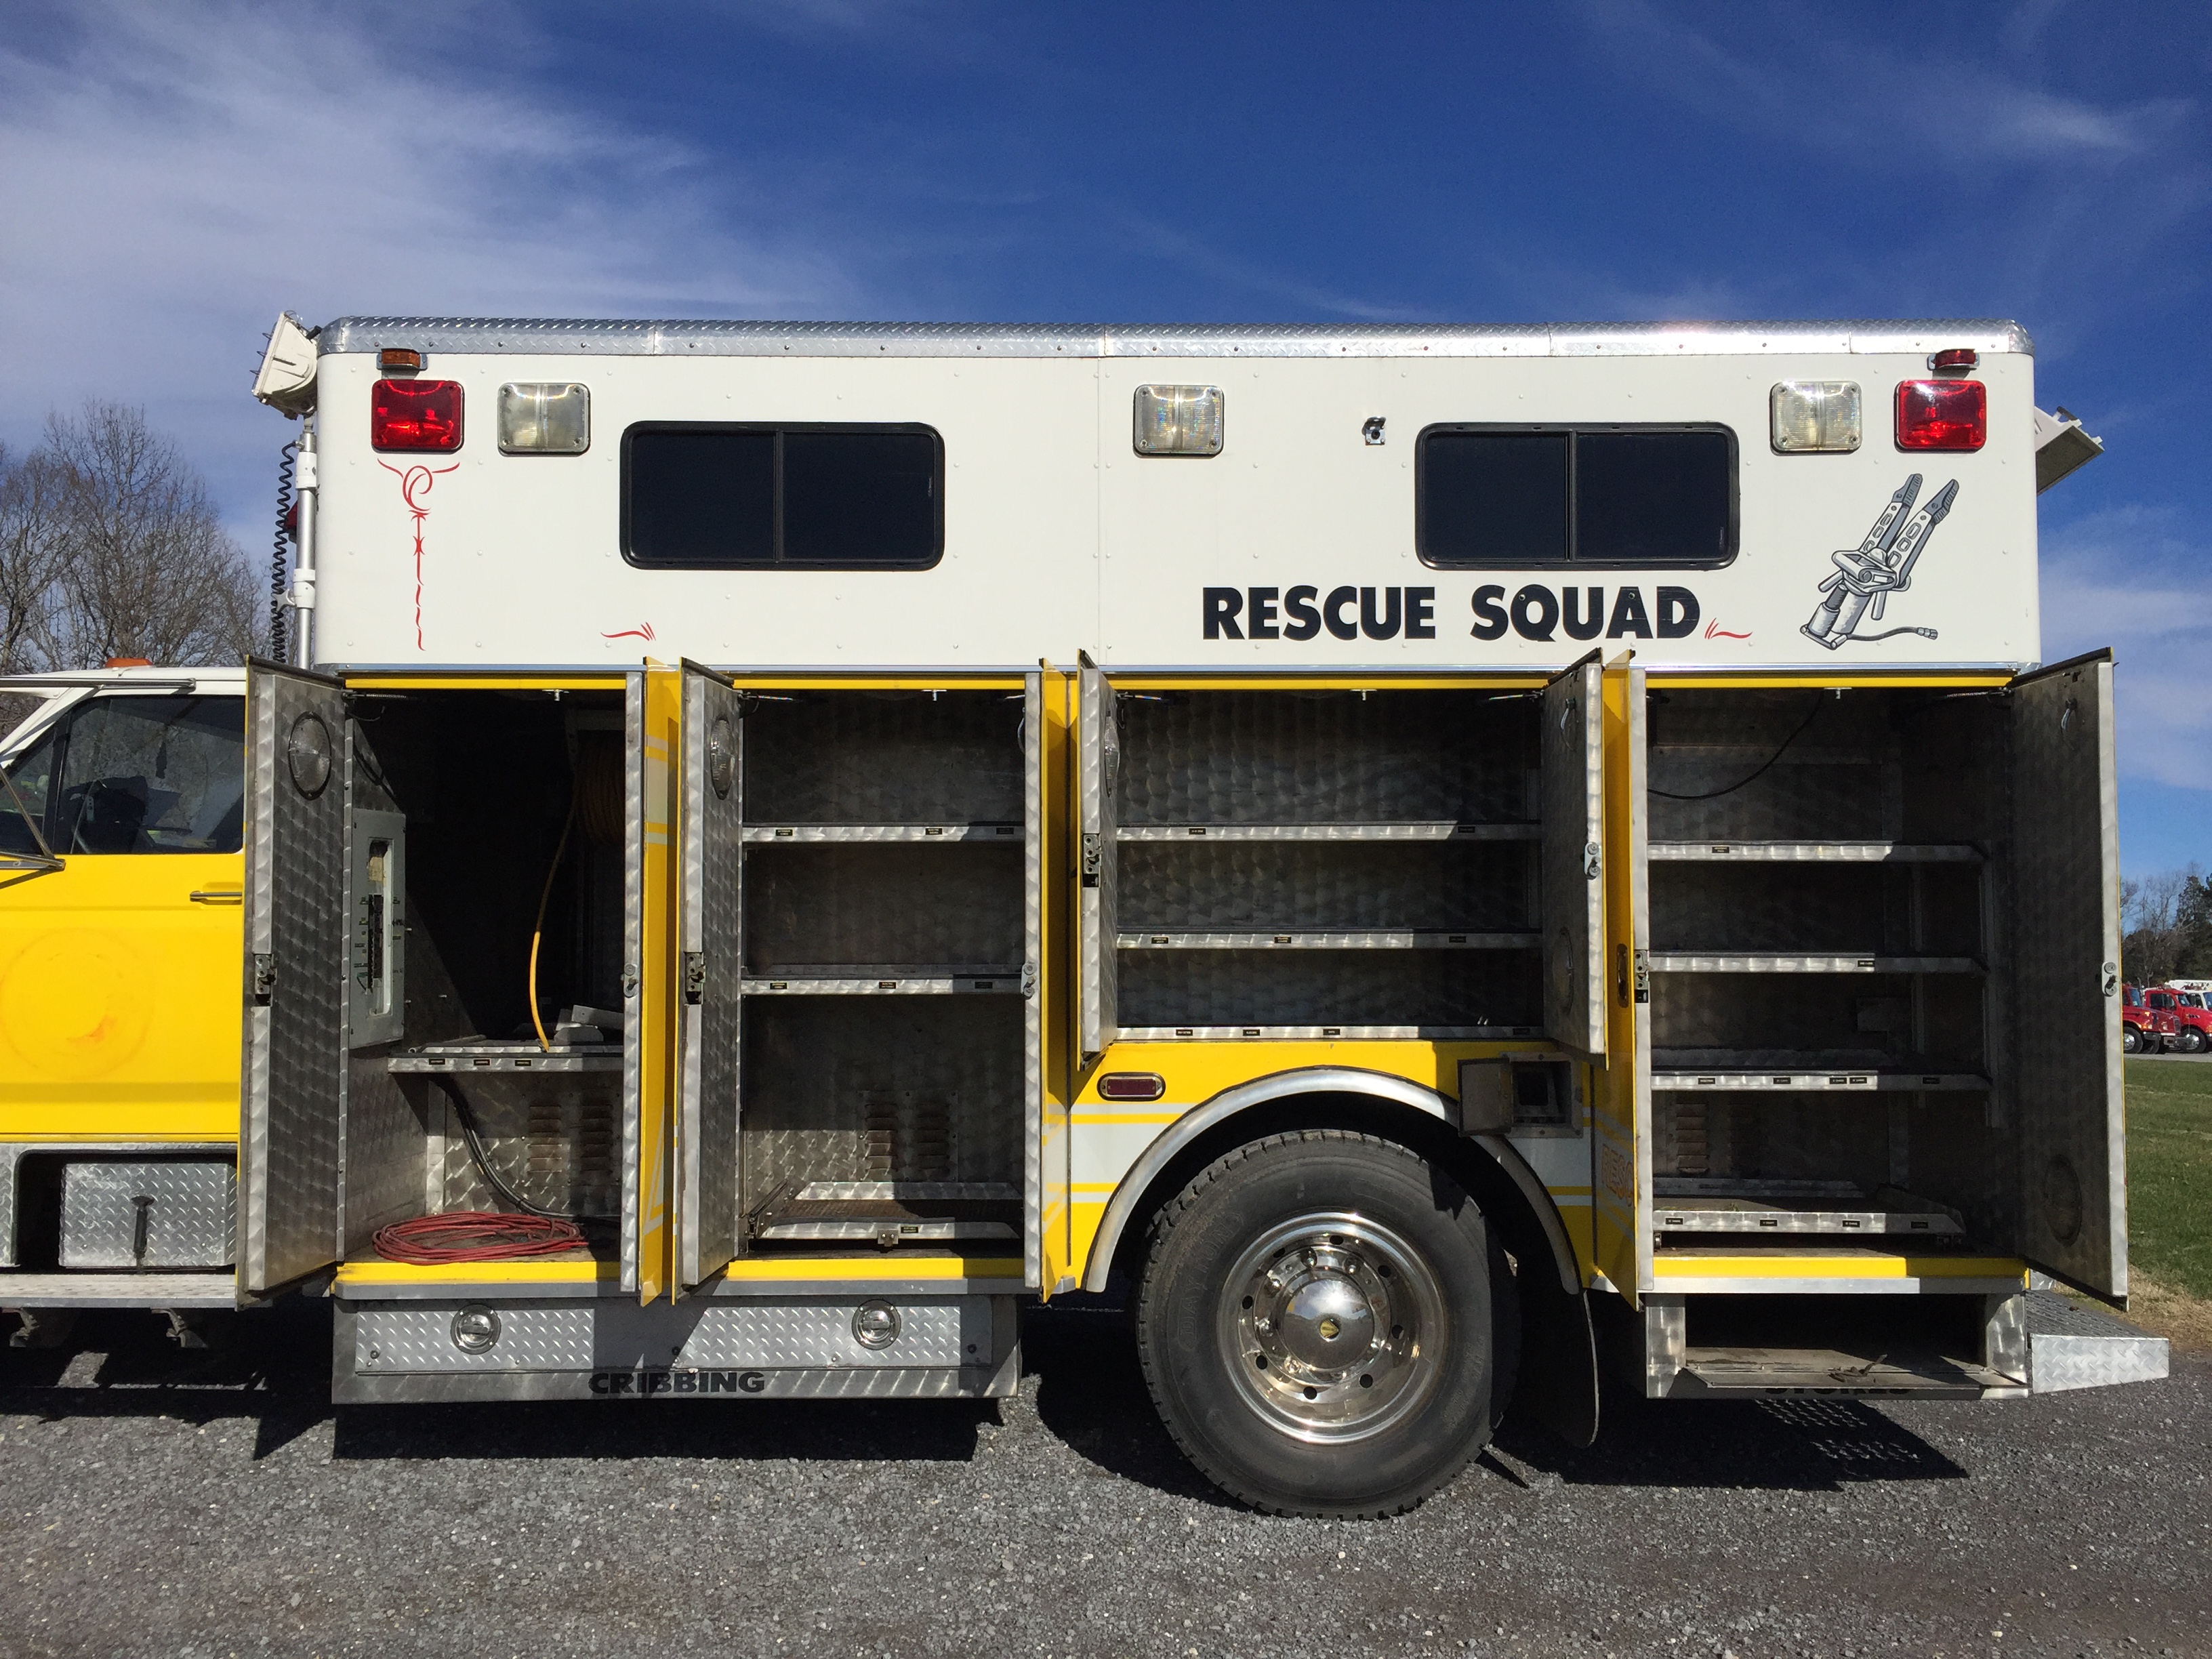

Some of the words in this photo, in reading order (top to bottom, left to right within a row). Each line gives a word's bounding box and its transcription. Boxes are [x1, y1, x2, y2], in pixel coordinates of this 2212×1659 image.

[1203, 585, 1435, 641] RESCUE
[1469, 583, 1700, 642] SQUAD
[588, 1372, 765, 1393] CRIBBING
